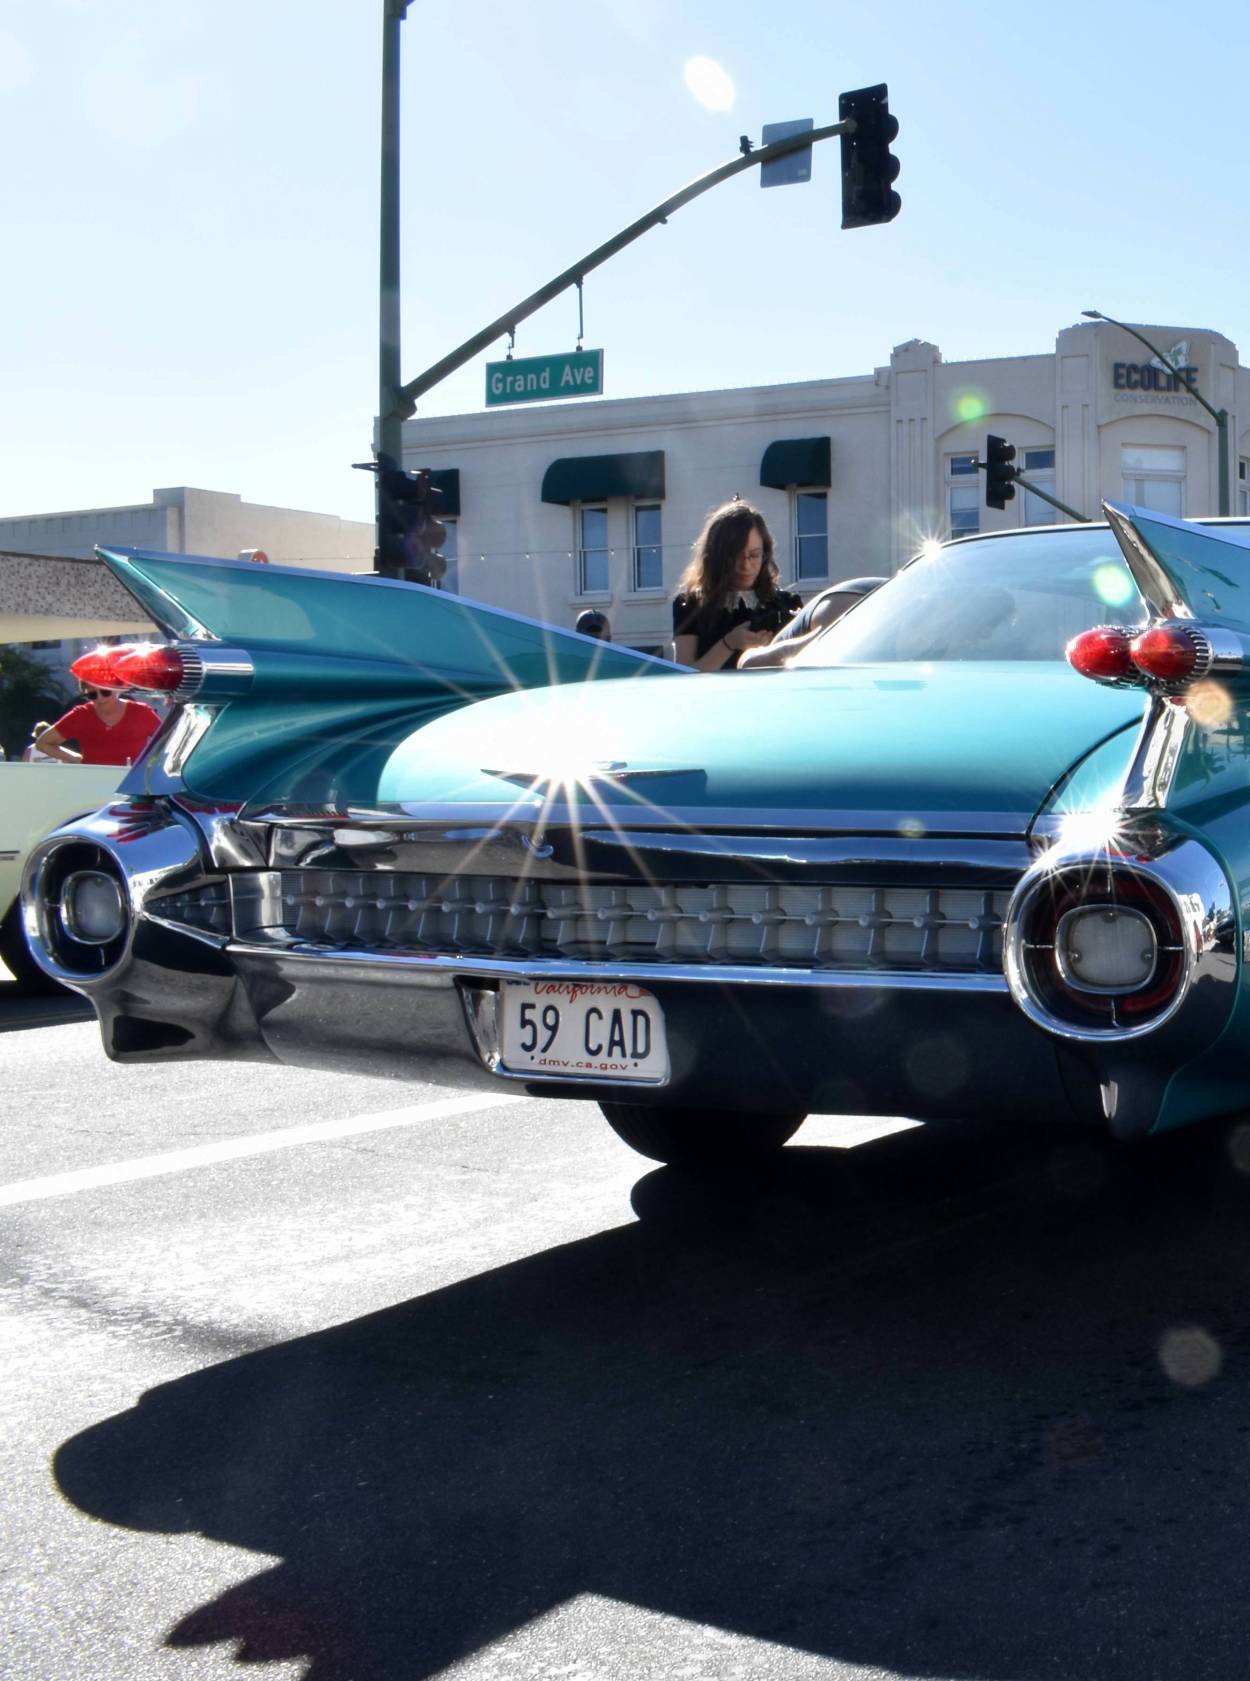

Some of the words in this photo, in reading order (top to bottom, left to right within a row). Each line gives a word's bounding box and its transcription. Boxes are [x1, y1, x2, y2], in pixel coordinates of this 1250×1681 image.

[491, 367, 550, 394] Grand
[560, 364, 594, 387] Ave
[1113, 362, 1199, 393] ECOLIFE
[520, 1003, 560, 1053] 59
[584, 1007, 651, 1059] CAD
[537, 1058, 629, 1071] dmv.ca.gov
